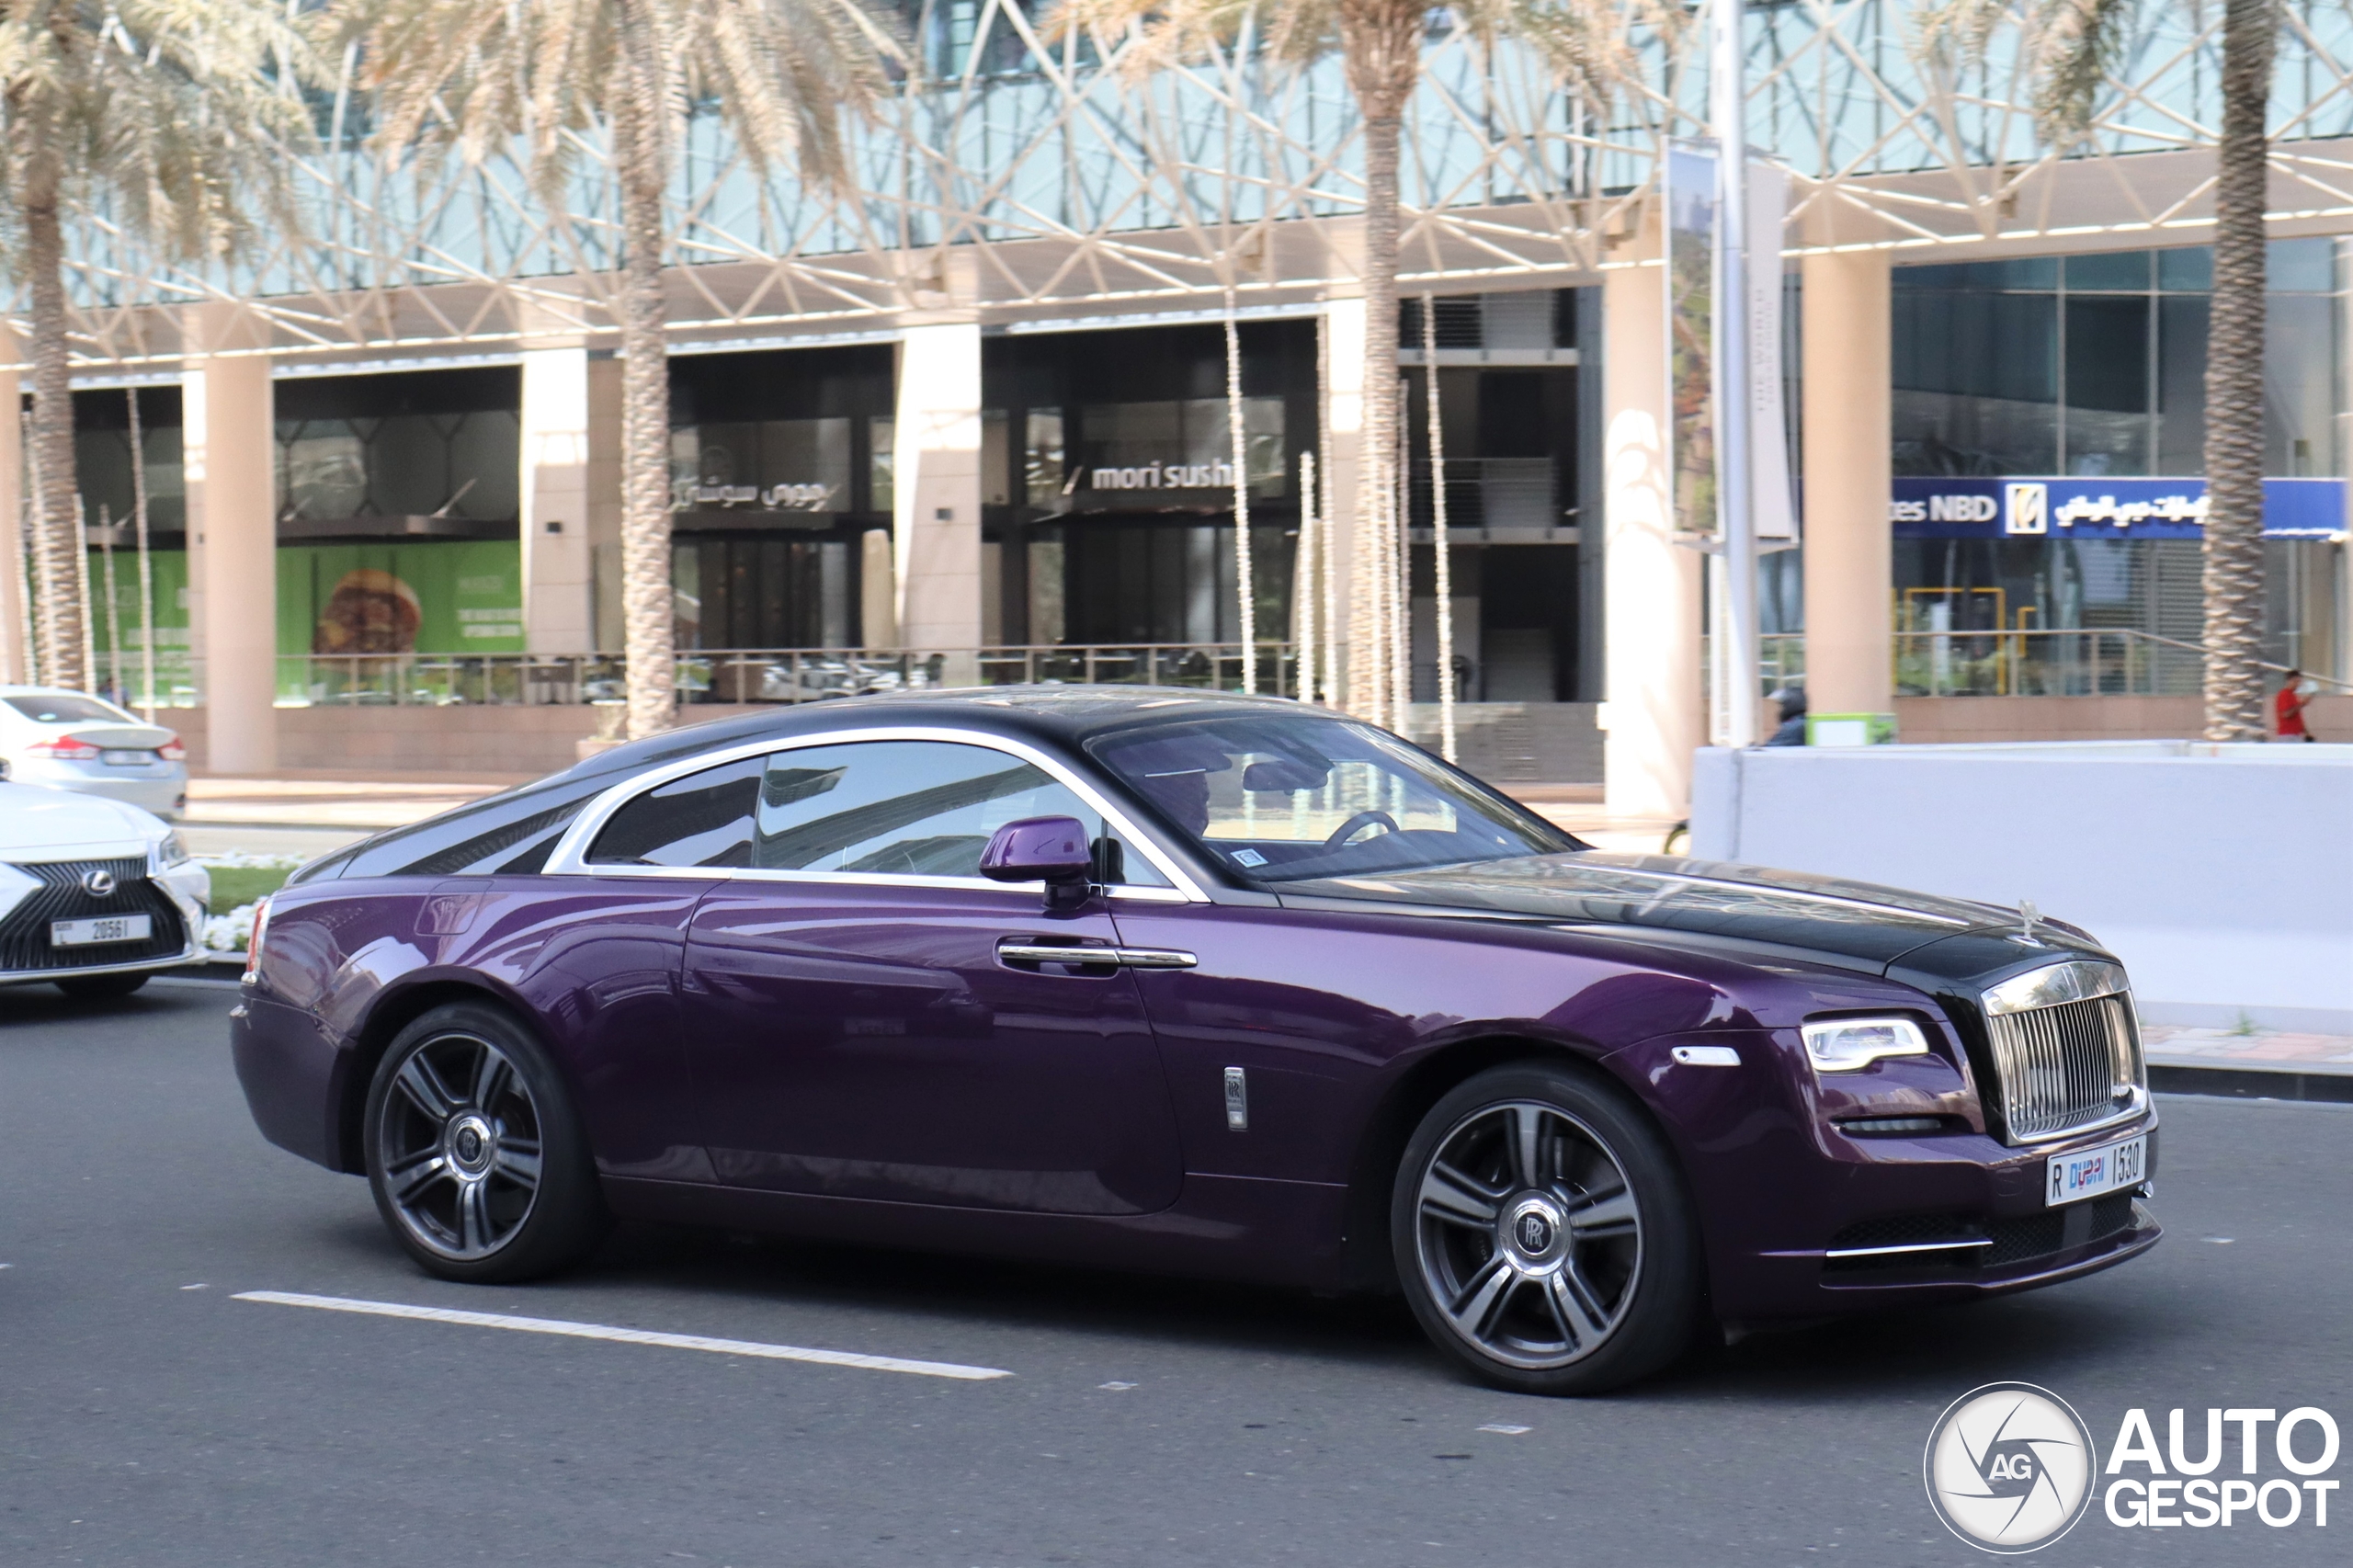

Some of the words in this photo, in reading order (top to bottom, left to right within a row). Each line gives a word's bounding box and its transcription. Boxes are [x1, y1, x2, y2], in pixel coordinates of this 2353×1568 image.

[1092, 460, 1160, 489] mori
[1163, 457, 1236, 489] sush
[1929, 494, 1998, 522] NBD
[93, 920, 128, 939] 20561
[2052, 1164, 2063, 1199] R
[2113, 1142, 2140, 1186] 1530
